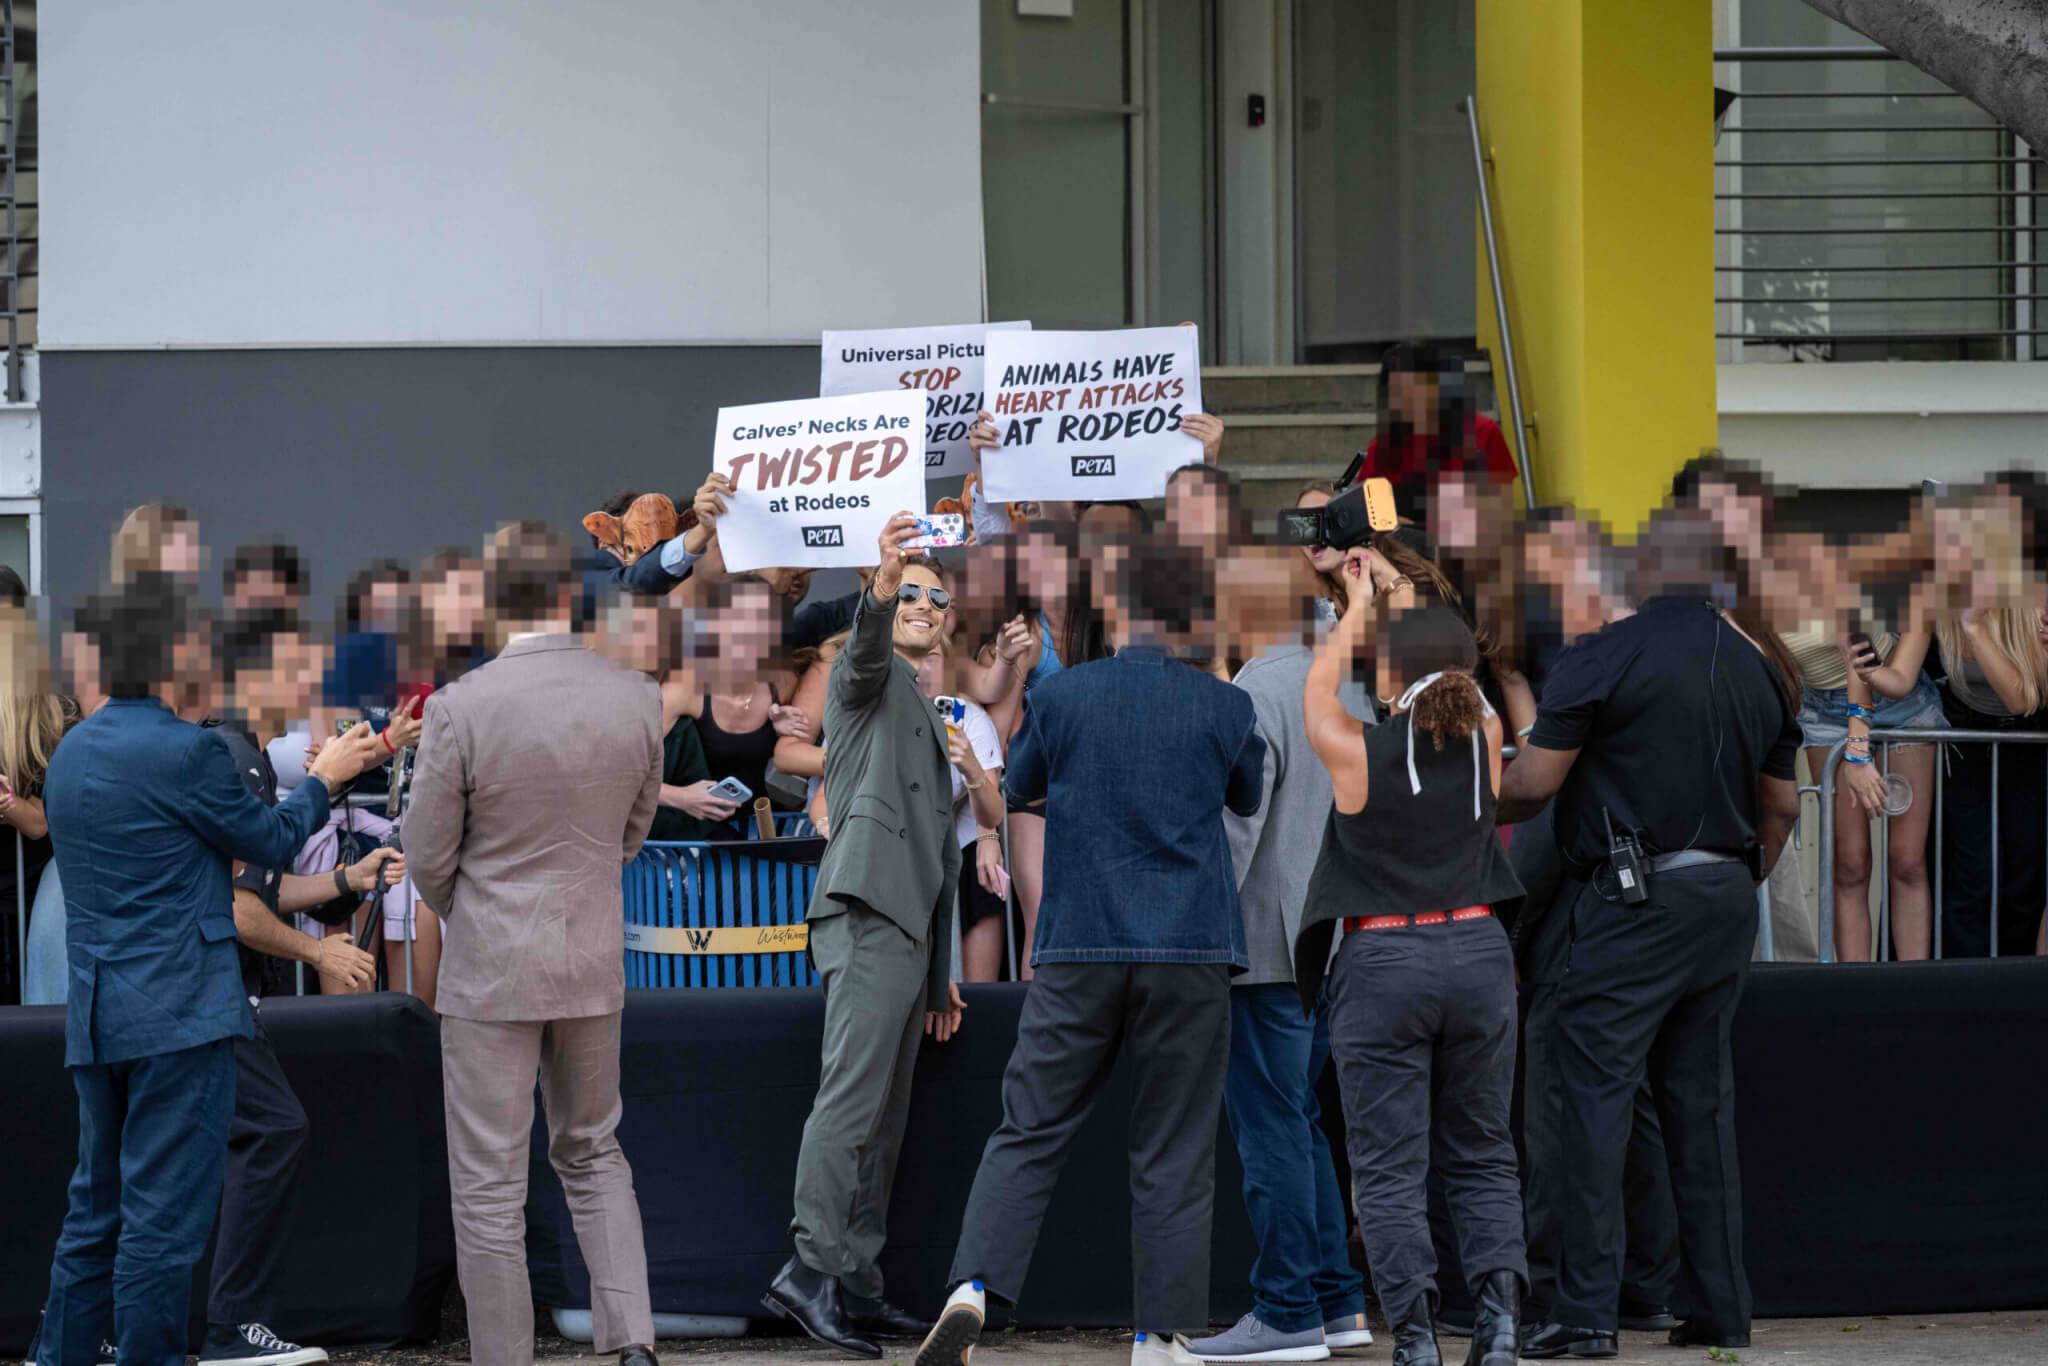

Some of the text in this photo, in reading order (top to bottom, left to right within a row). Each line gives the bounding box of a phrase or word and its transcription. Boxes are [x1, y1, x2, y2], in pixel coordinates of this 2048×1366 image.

[841, 344, 931, 363] Universal
[899, 366, 961, 391] STOP
[1000, 352, 1175, 388] ANIMALS HAVE
[995, 377, 1184, 415] HEART ATTACKS
[808, 416, 868, 434] Necks
[873, 414, 910, 430] Are
[1003, 403, 1183, 447] AT RODEOS
[727, 436, 909, 492] TWISTED
[769, 493, 870, 513] at Rodeos
